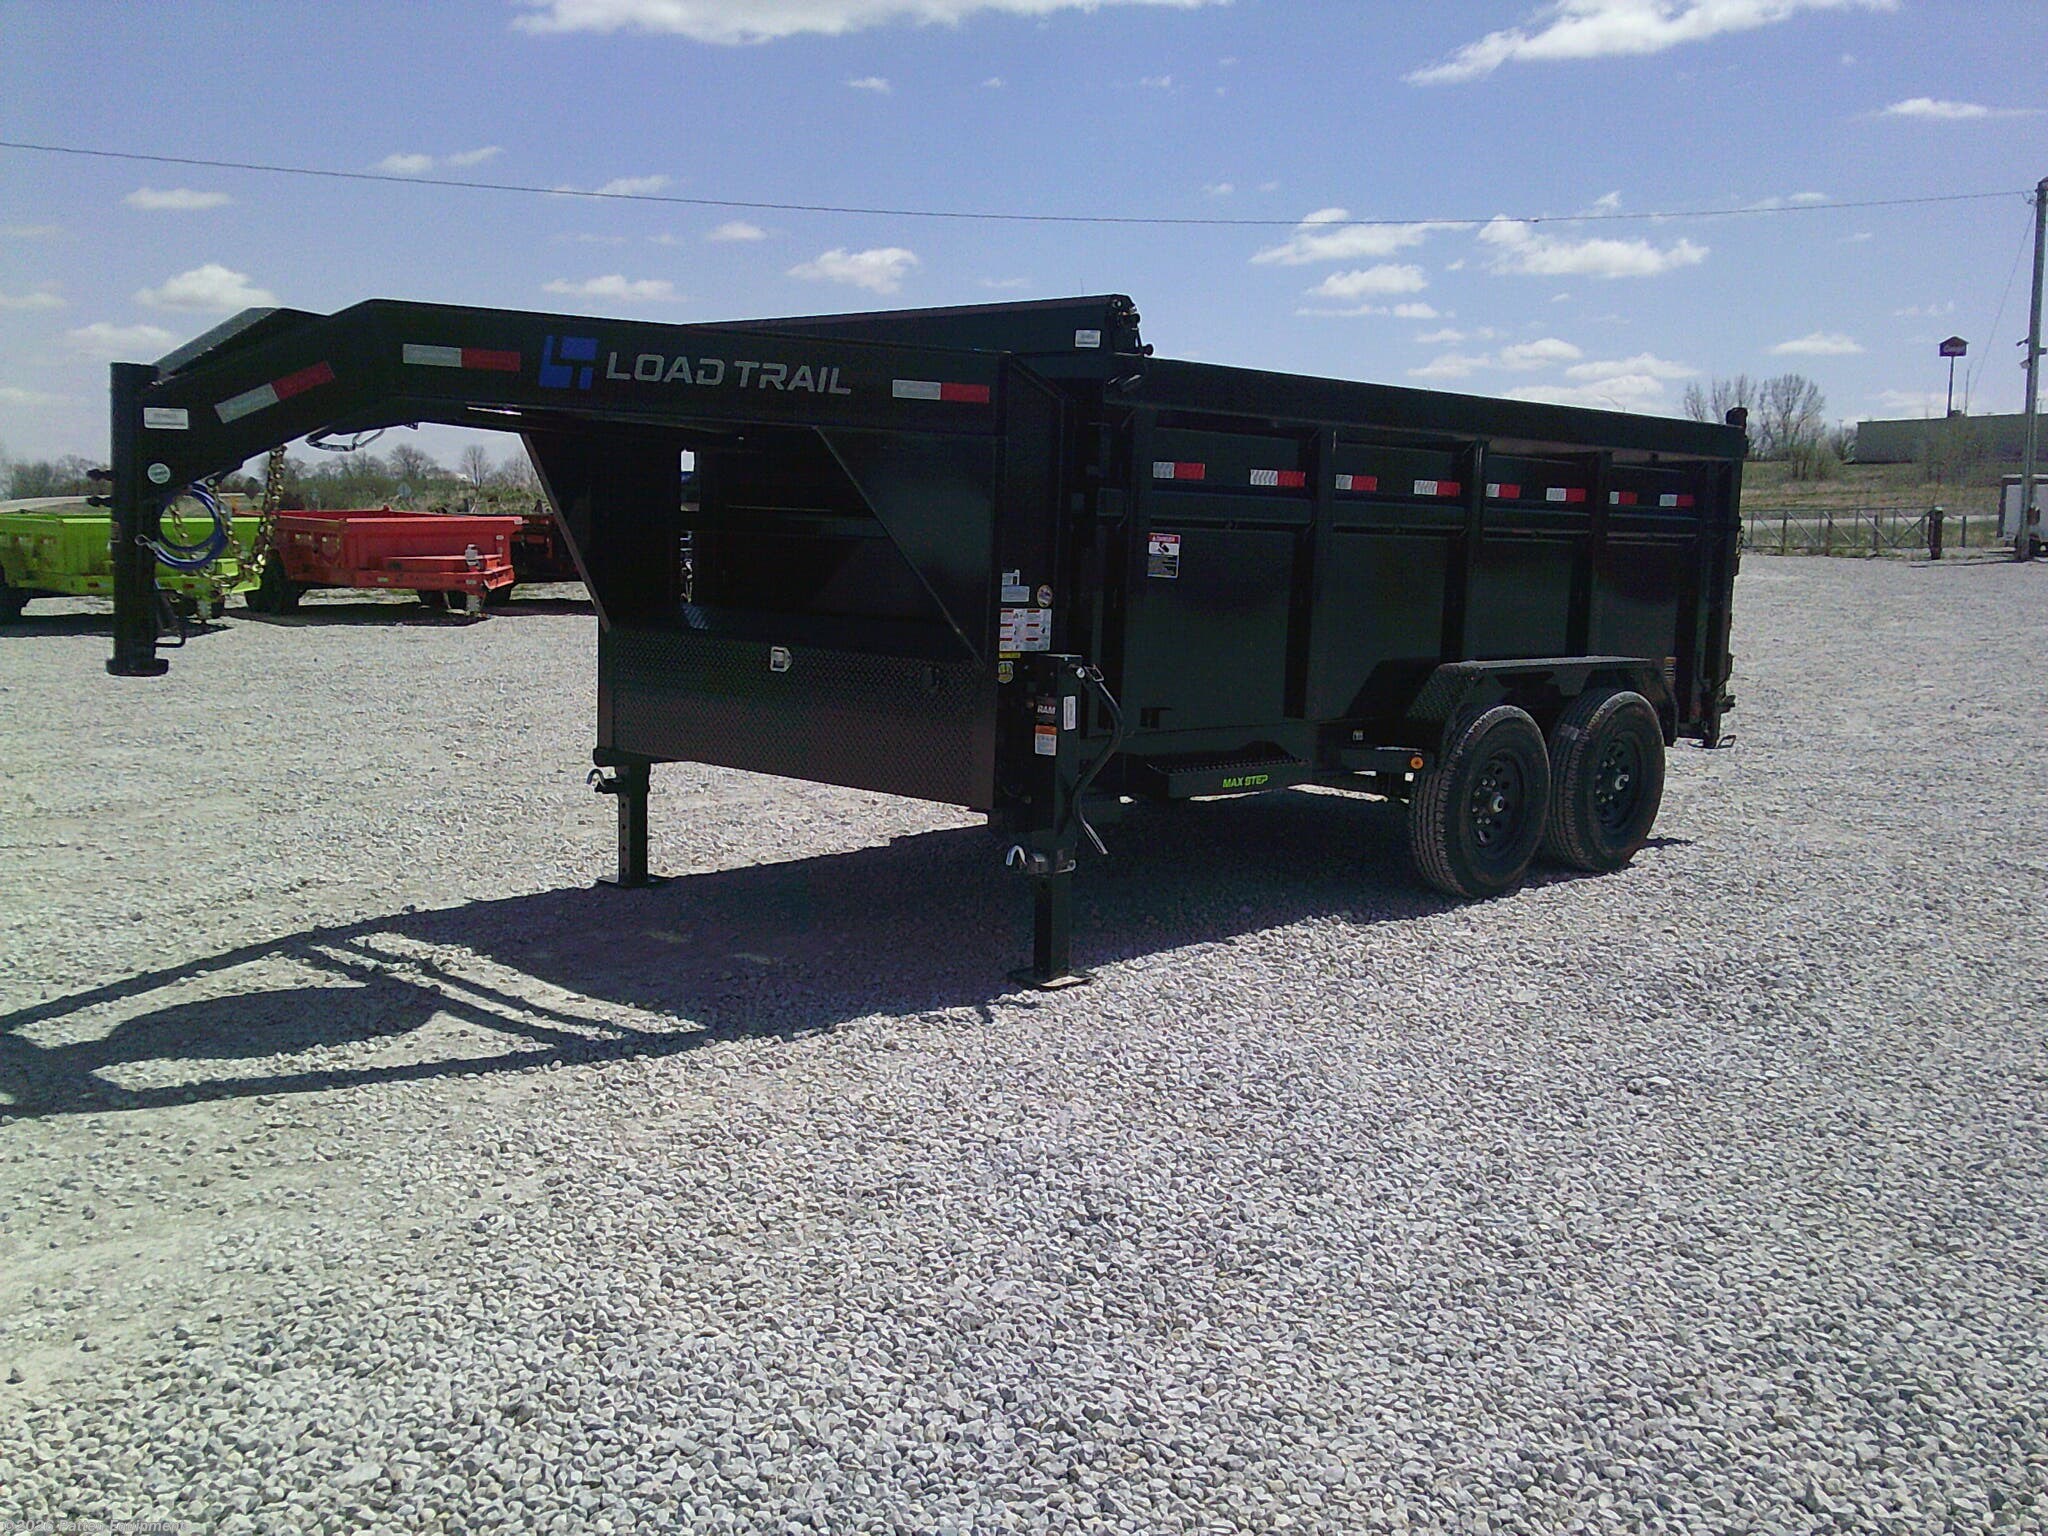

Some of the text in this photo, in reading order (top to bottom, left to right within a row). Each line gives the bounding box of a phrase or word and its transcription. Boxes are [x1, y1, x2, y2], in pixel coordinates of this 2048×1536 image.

[605, 351, 851, 395] LOAD TRAIL
[1037, 704, 1056, 715] RAM
[1222, 774, 1268, 788] MAX STEP
